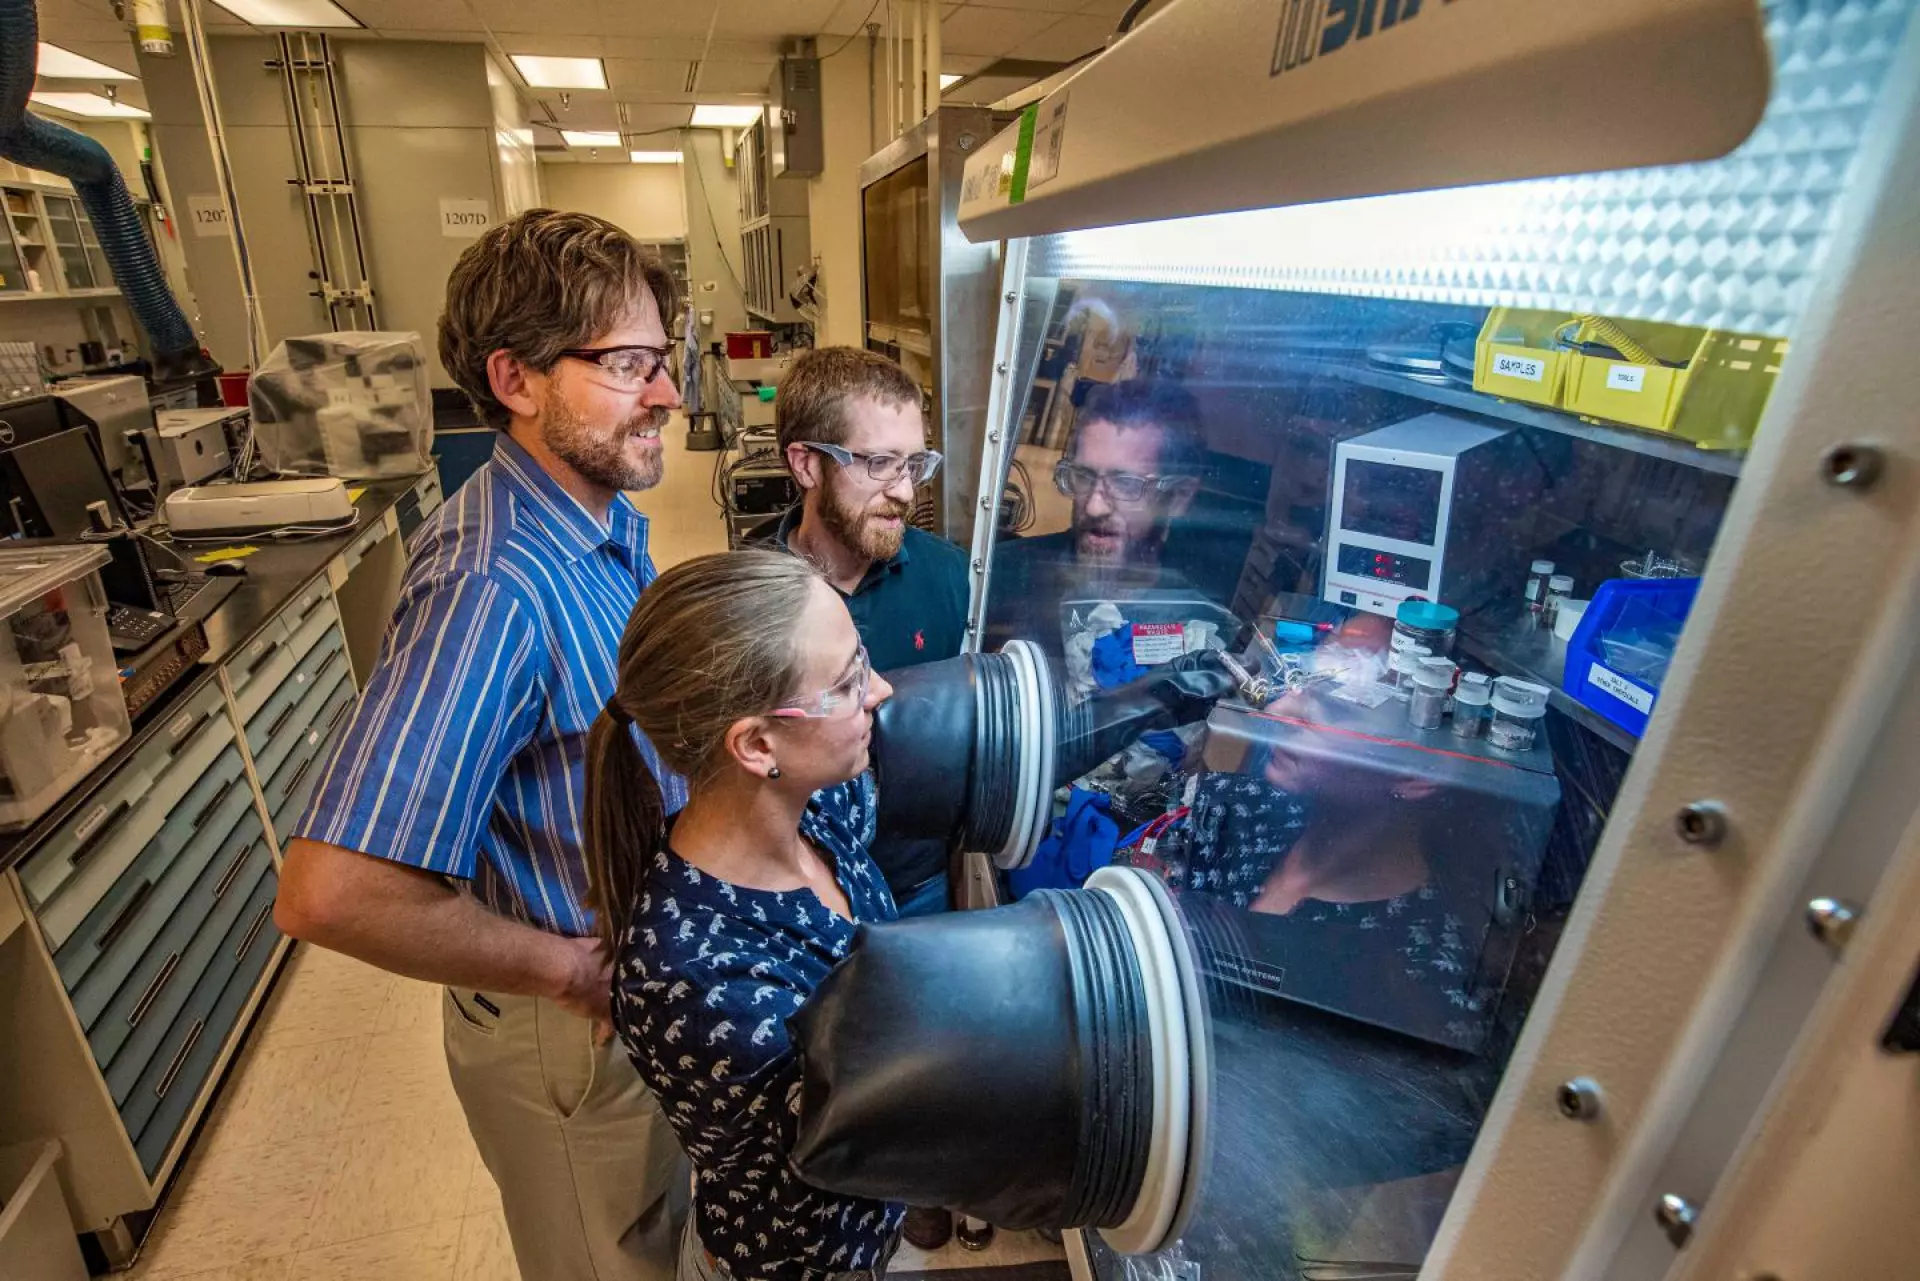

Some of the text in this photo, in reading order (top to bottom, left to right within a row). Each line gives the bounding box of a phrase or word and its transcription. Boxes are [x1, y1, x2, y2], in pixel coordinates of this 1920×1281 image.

[446, 212, 487, 225] 1207D
[1499, 359, 1537, 376] SAMPLES
[1241, 967, 1281, 982] SYSTEMS
